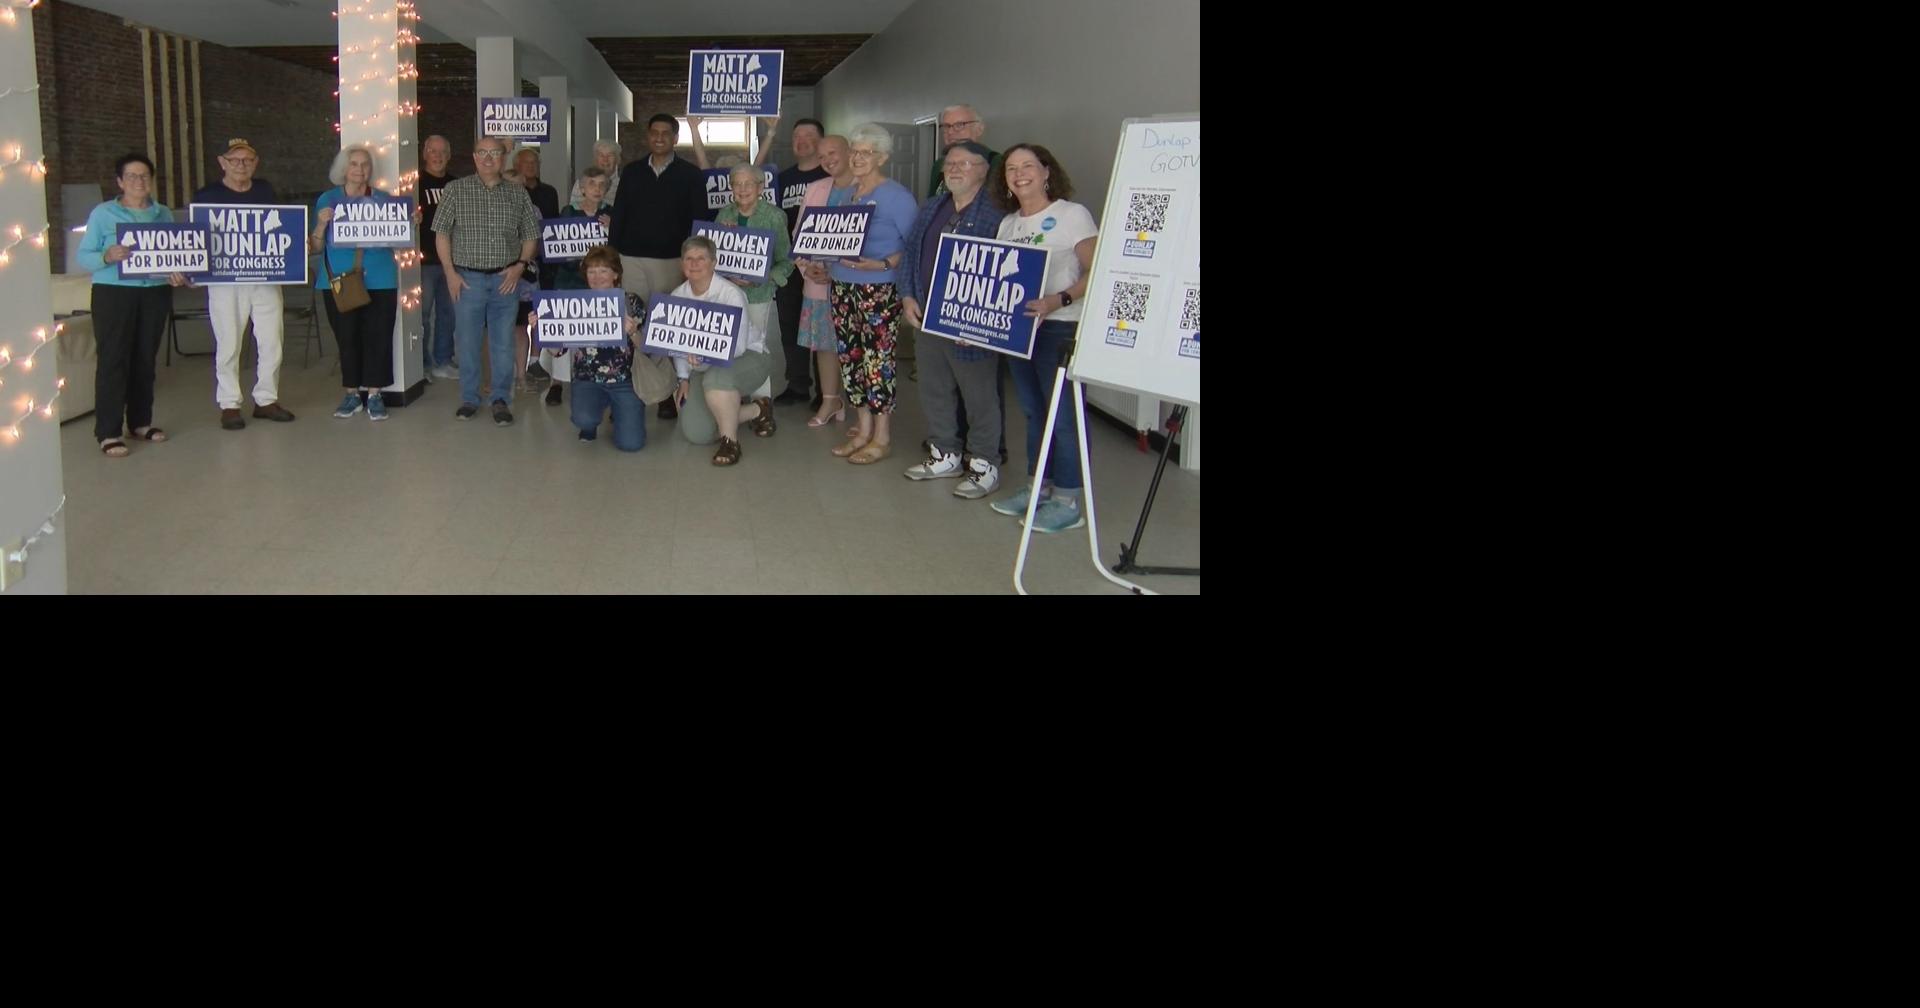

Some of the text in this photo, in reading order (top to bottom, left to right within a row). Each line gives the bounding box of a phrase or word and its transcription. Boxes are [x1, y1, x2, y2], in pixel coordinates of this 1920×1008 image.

[703, 54, 747, 73] MATT
[702, 74, 768, 92] DUNLAP
[702, 93, 762, 104] FOR CONGRESS
[495, 104, 547, 120] DUNLAP
[488, 122, 545, 132] FOR CONGRESS
[718, 171, 774, 191] DUP
[710, 195, 726, 204] FOR
[346, 202, 408, 220] WOMEN
[209, 209, 264, 232] MATT
[814, 213, 868, 233] WOMEN
[136, 230, 205, 250] WOMEN
[338, 225, 406, 237] FOR DUNLAP
[210, 233, 292, 256] DUNLAP
[548, 244, 567, 254] FOR
[708, 229, 769, 255] WOMEN
[800, 237, 860, 250] FOR DUNLAP
[127, 253, 204, 268] FOR DUNLAP
[232, 257, 285, 269] CONGRESS
[719, 254, 763, 271] DUNLAP
[950, 241, 1004, 278] MATT
[944, 271, 1025, 314] DUNLAP
[551, 297, 619, 319] WOMEN
[940, 301, 1012, 331] FOR CONGRESS
[667, 303, 734, 336] WOMEN
[543, 322, 618, 336] FOR DUNLAP
[652, 327, 728, 353] FOR DUNLAP
